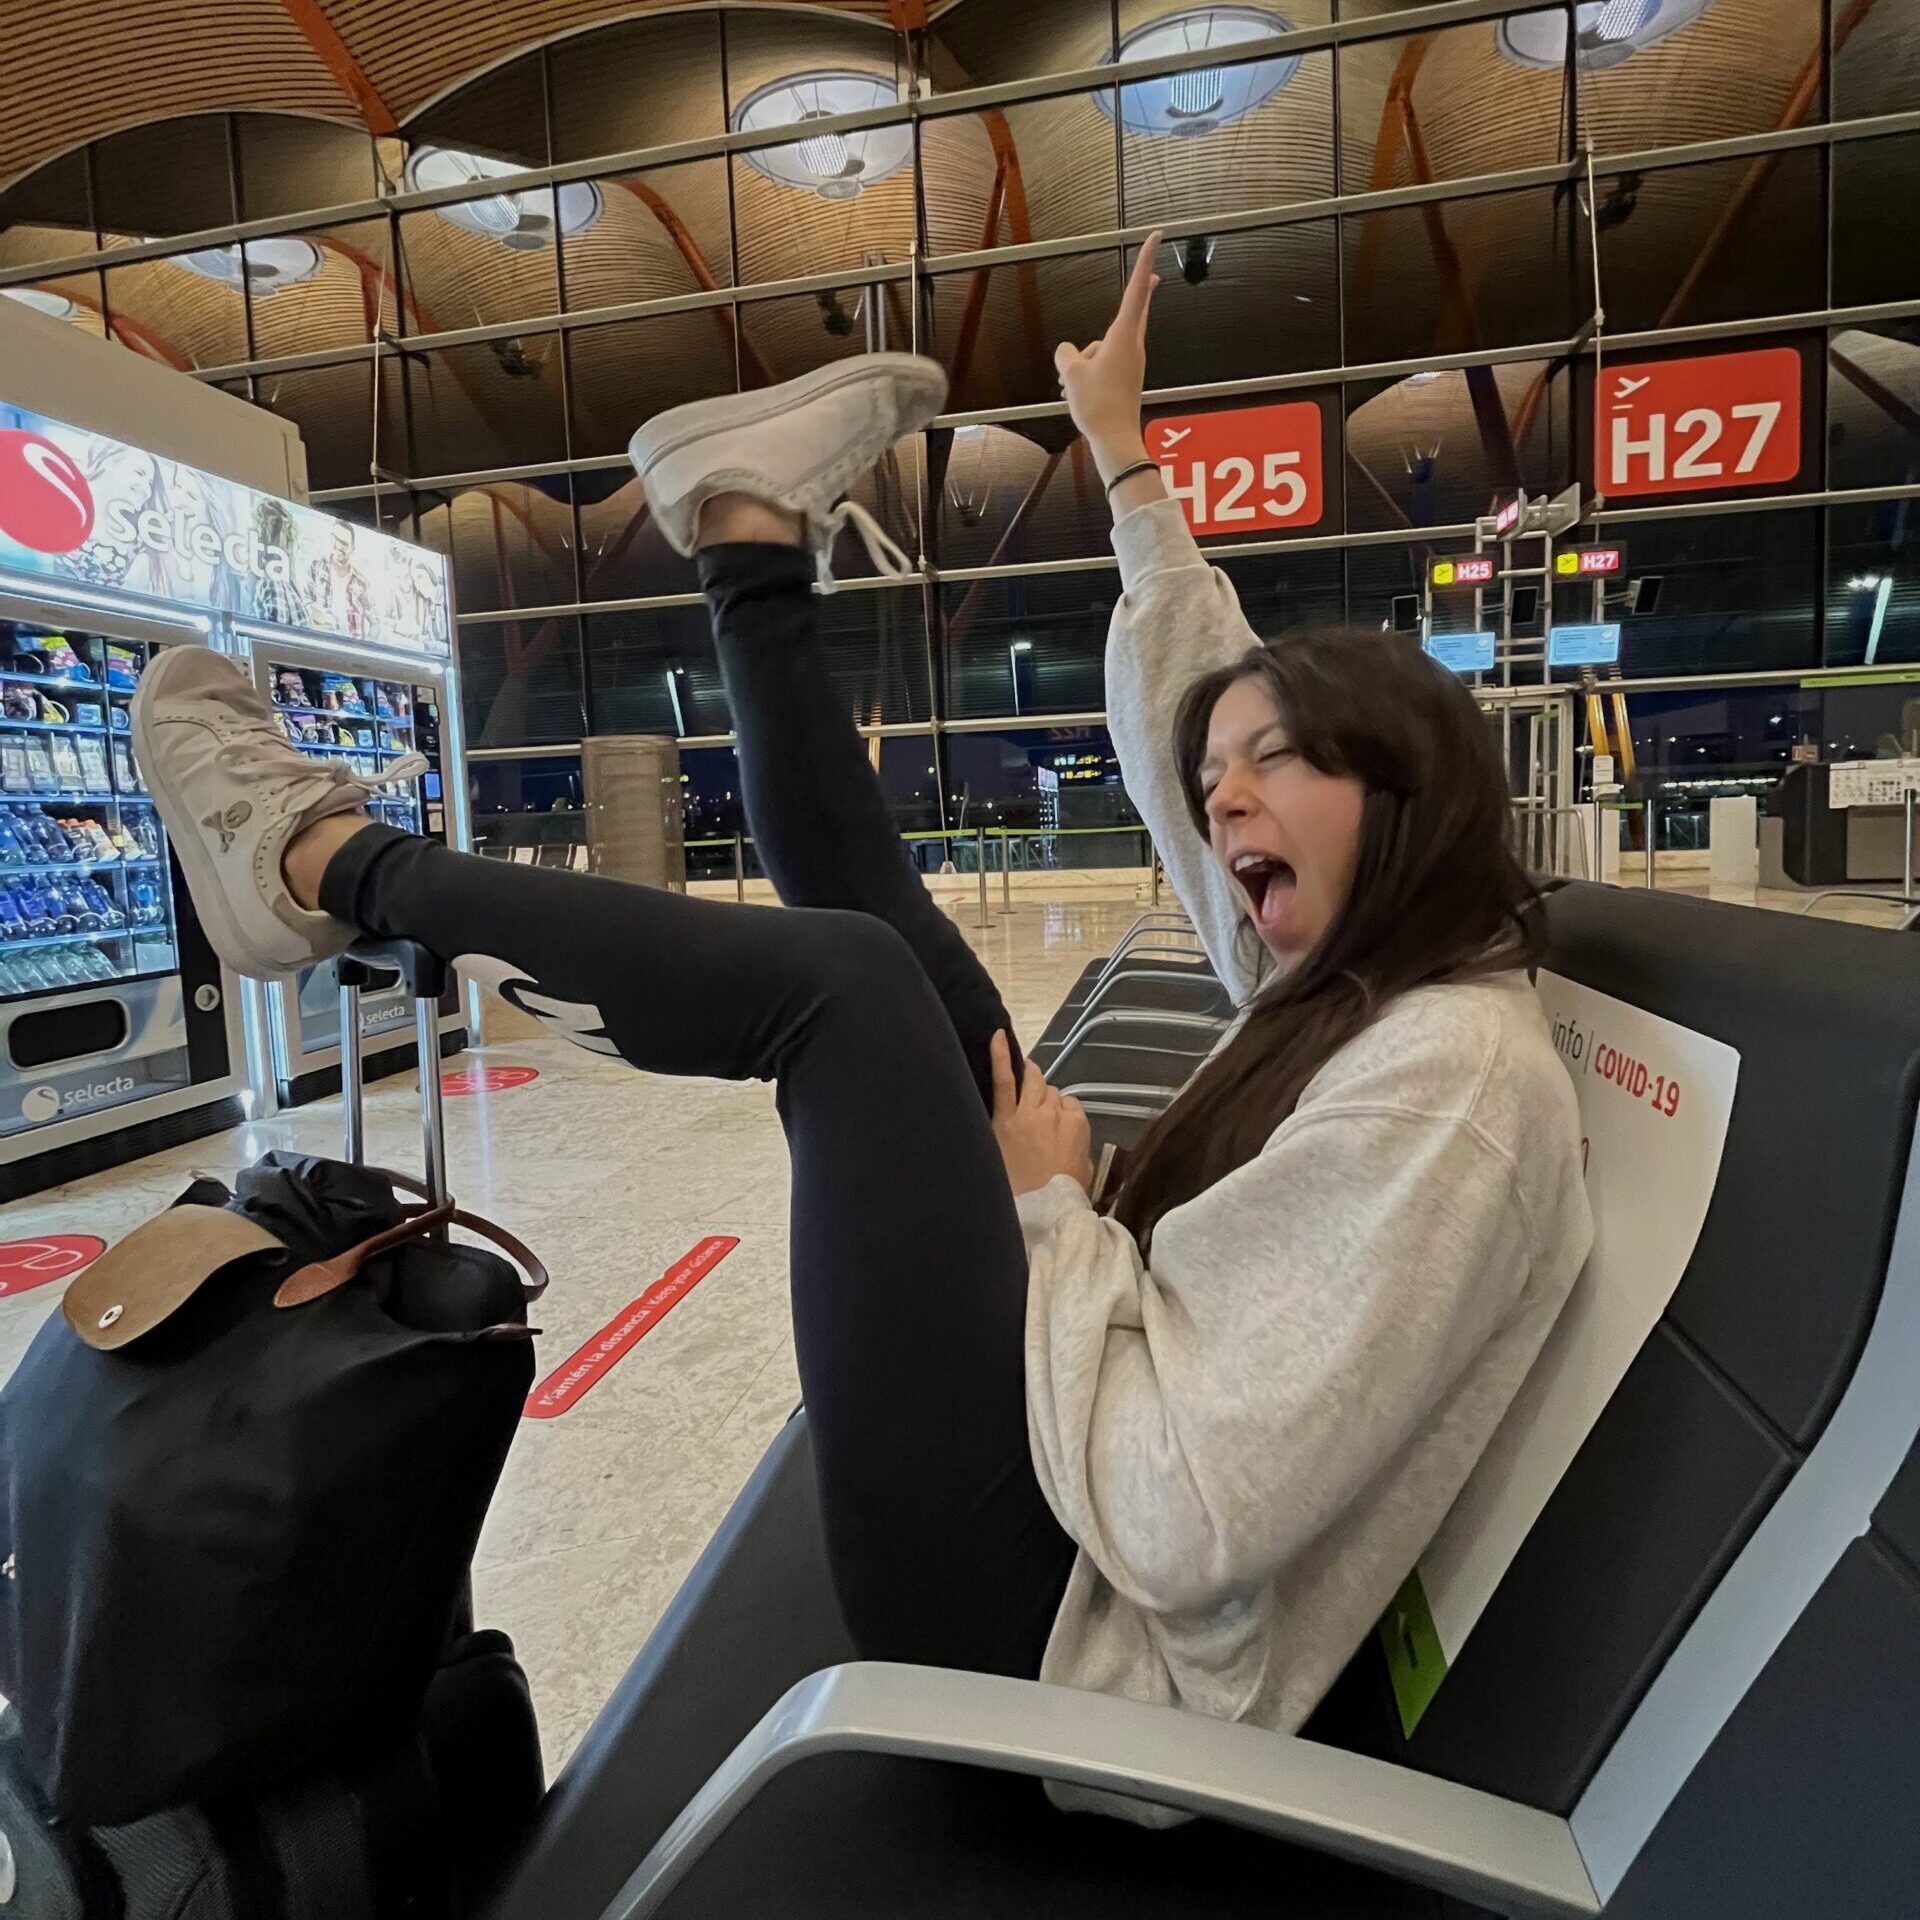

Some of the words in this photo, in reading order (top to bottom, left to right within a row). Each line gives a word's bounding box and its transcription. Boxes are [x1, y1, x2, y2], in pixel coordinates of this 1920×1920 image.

[1611, 401, 1782, 485] H27
[1160, 451, 1307, 524] H25
[106, 498, 291, 583] selecta
[1583, 553, 1617, 569] H27
[1458, 563, 1490, 579] H25
[366, 1005, 406, 1025] selecta
[1552, 1012, 1584, 1059] info
[1595, 1043, 1681, 1118] COVID-19
[64, 1076, 135, 1104] selecta
[600, 1309, 651, 1352] distancia
